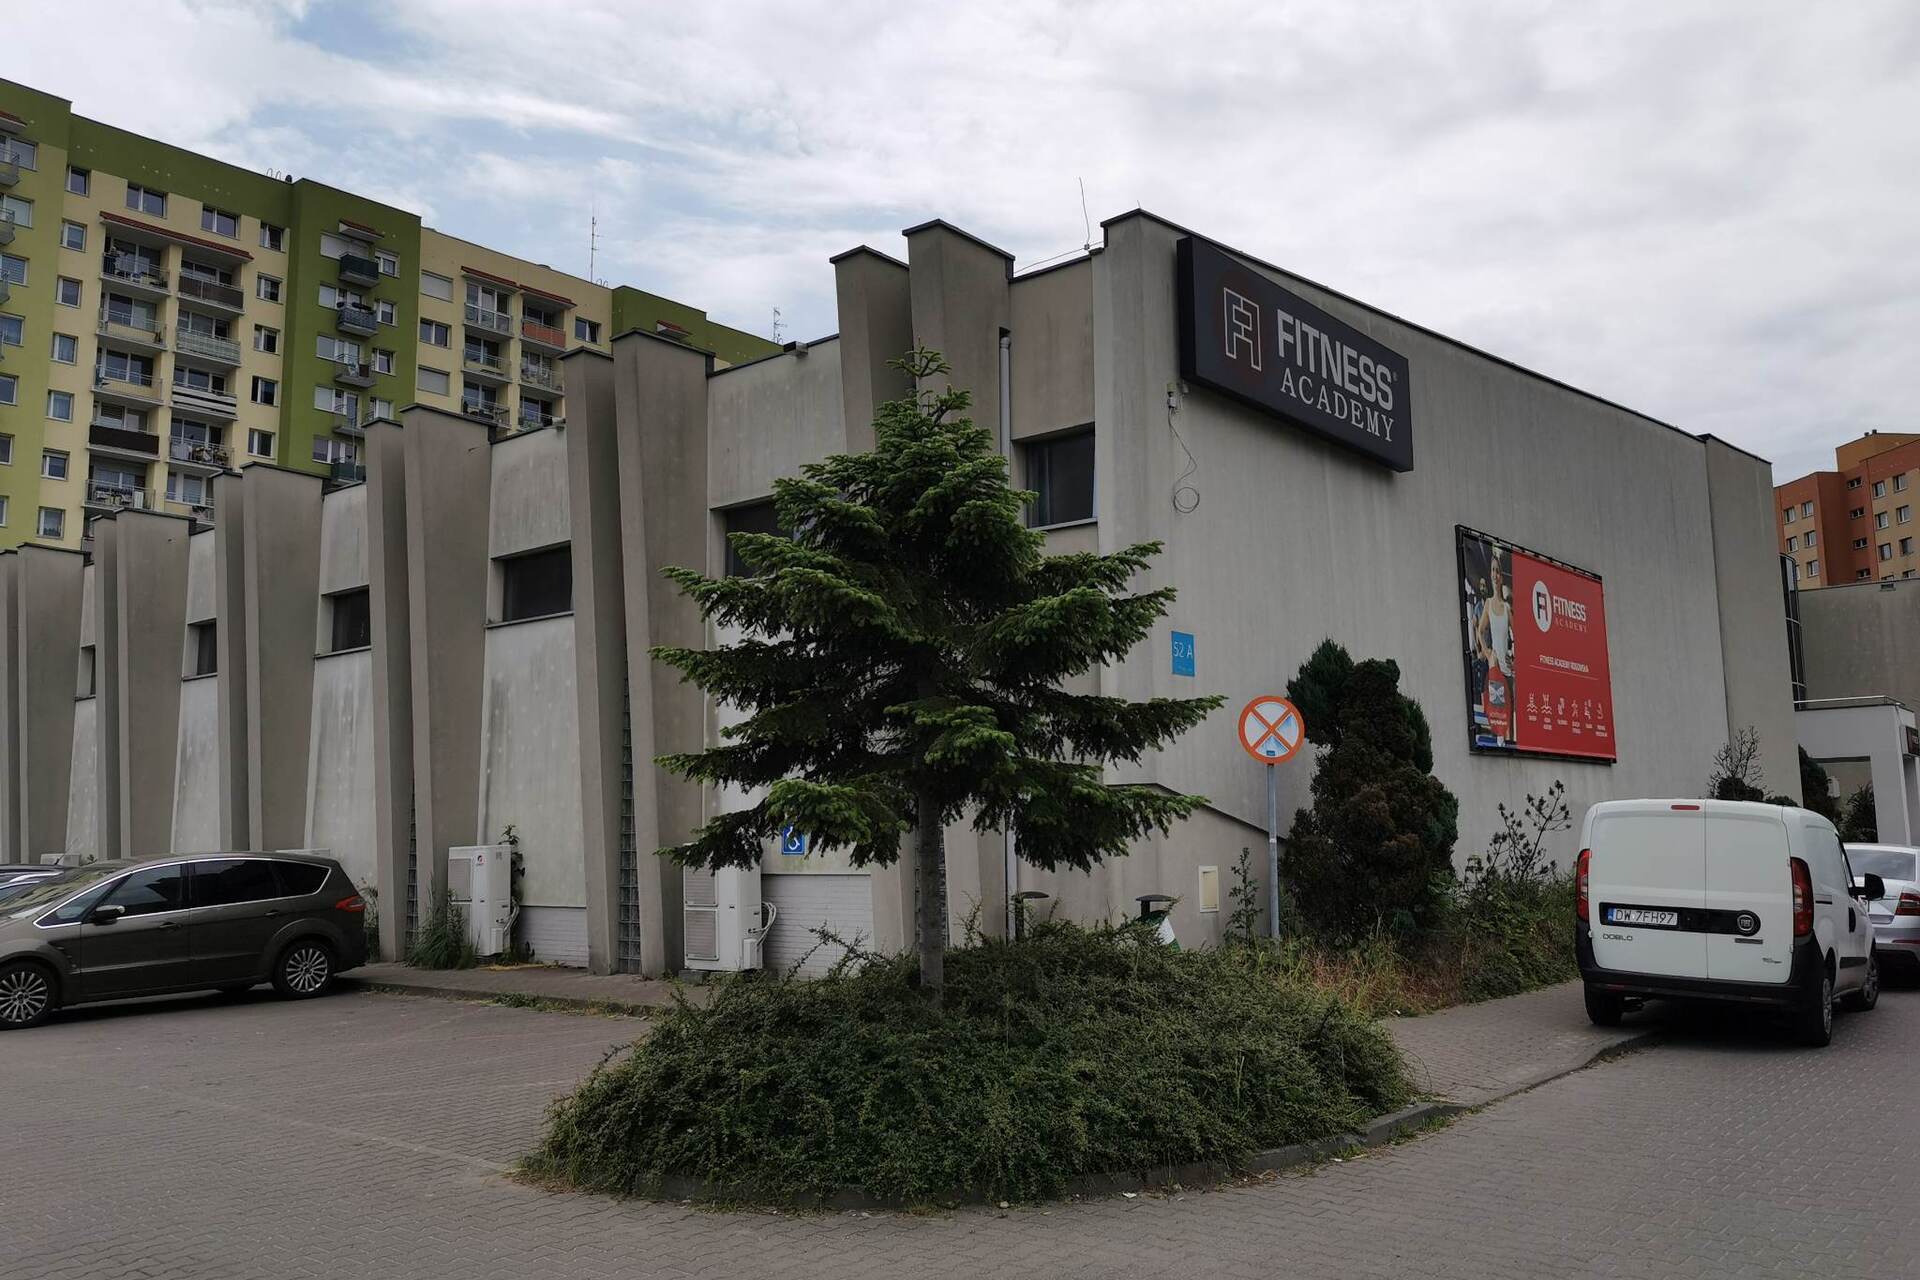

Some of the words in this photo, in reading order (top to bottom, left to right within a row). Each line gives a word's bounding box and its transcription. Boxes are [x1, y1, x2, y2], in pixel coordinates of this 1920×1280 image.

[1277, 308, 1393, 411] FITNESS
[1280, 367, 1395, 442] ACADEMY
[1553, 595, 1587, 622] FITNESS
[1554, 617, 1588, 633] ACADEMY
[1186, 643, 1193, 659] A
[1615, 909, 1632, 921] DW
[1635, 911, 1675, 924] 7FH97
